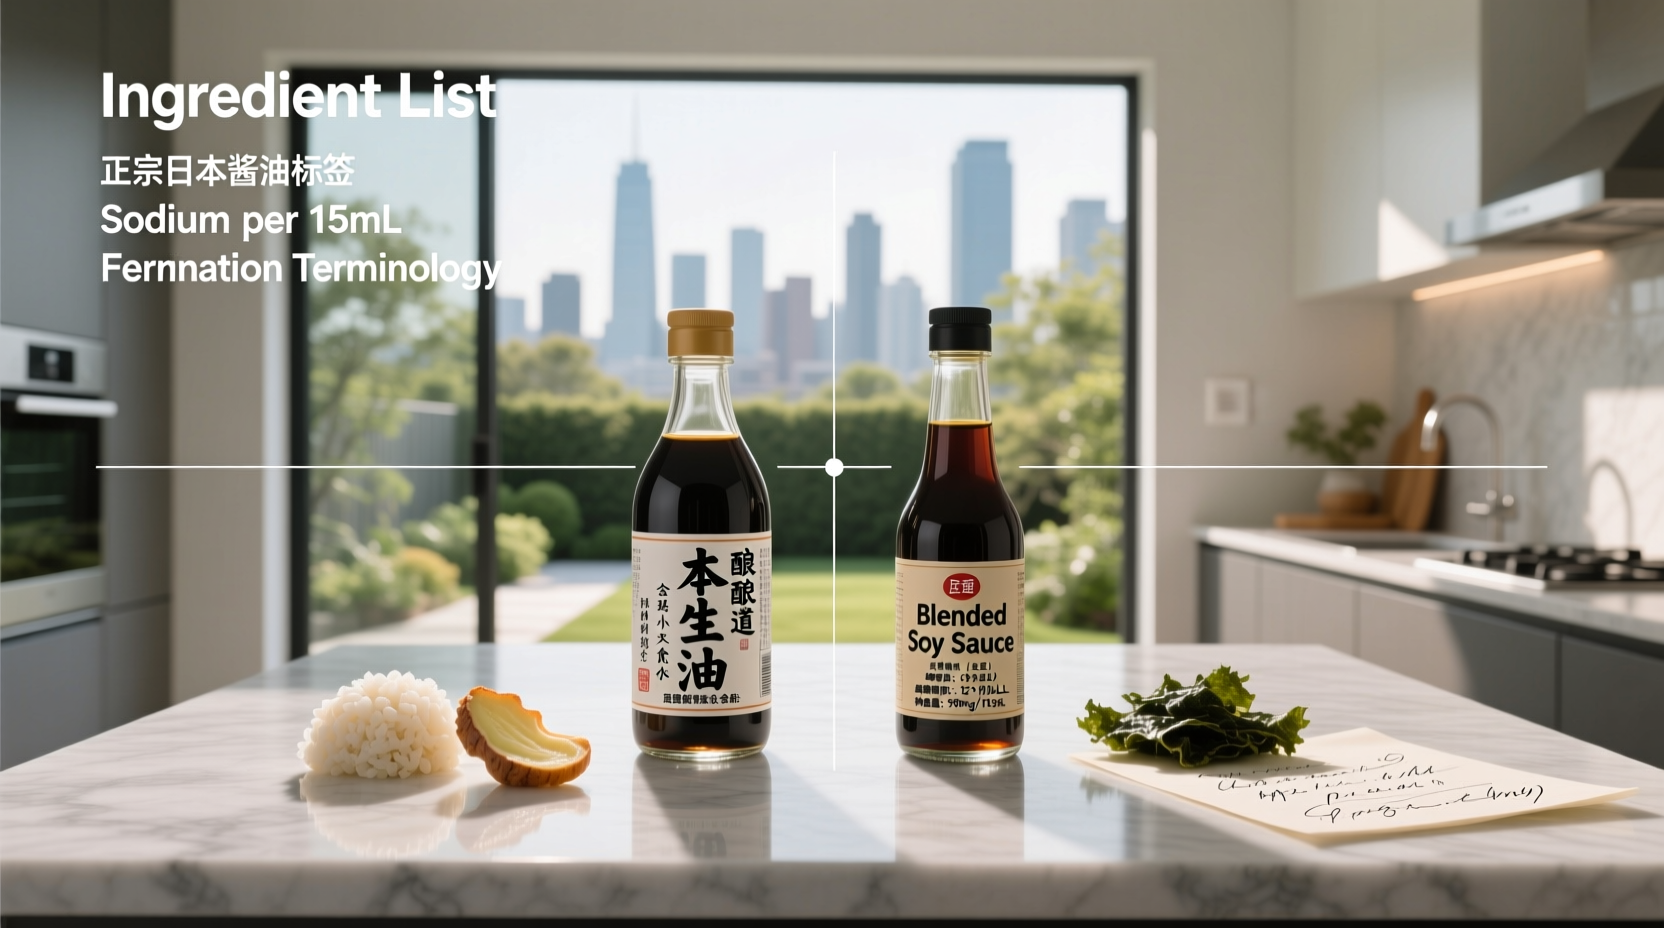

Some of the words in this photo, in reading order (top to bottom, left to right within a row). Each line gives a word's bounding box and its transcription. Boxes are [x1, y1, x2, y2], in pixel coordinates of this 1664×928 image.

[917, 602, 1007, 627] Blended
[908, 629, 945, 659] Soy
[951, 631, 1014, 654] Sauce
